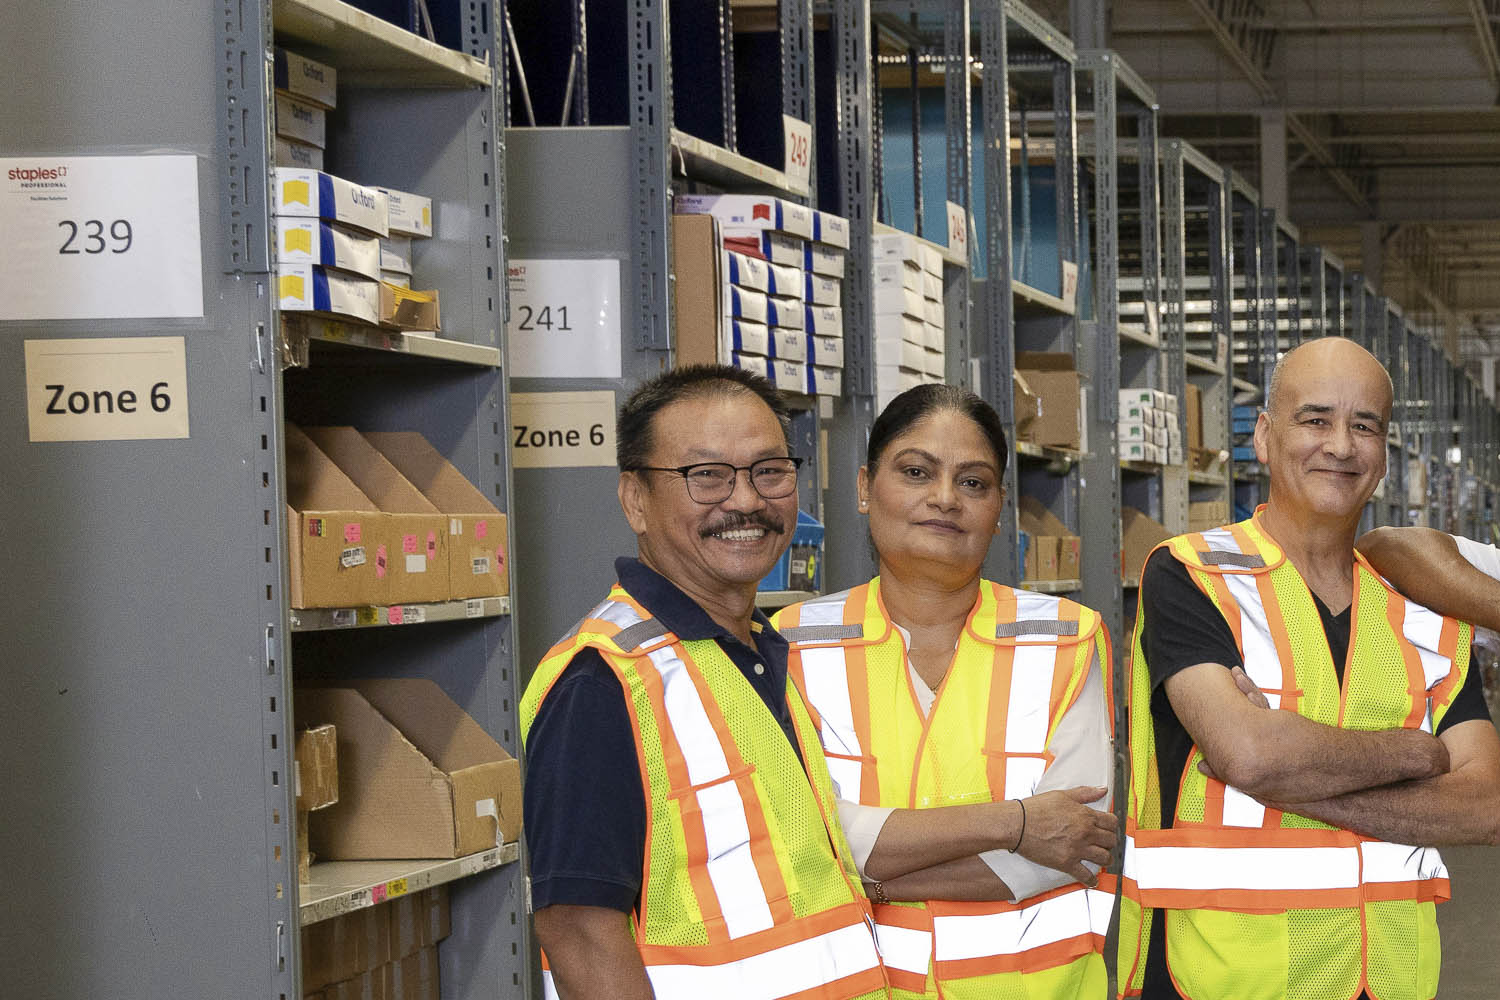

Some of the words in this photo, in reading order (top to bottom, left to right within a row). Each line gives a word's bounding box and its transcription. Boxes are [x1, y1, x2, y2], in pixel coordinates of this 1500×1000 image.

[791, 132, 807, 167] 243
[8, 167, 58, 181] staples
[58, 219, 133, 254] 239
[518, 305, 572, 331] 241
[45, 384, 137, 414] Zone
[150, 382, 171, 412] 6
[514, 426, 580, 447] Zone
[589, 424, 604, 446] 6
